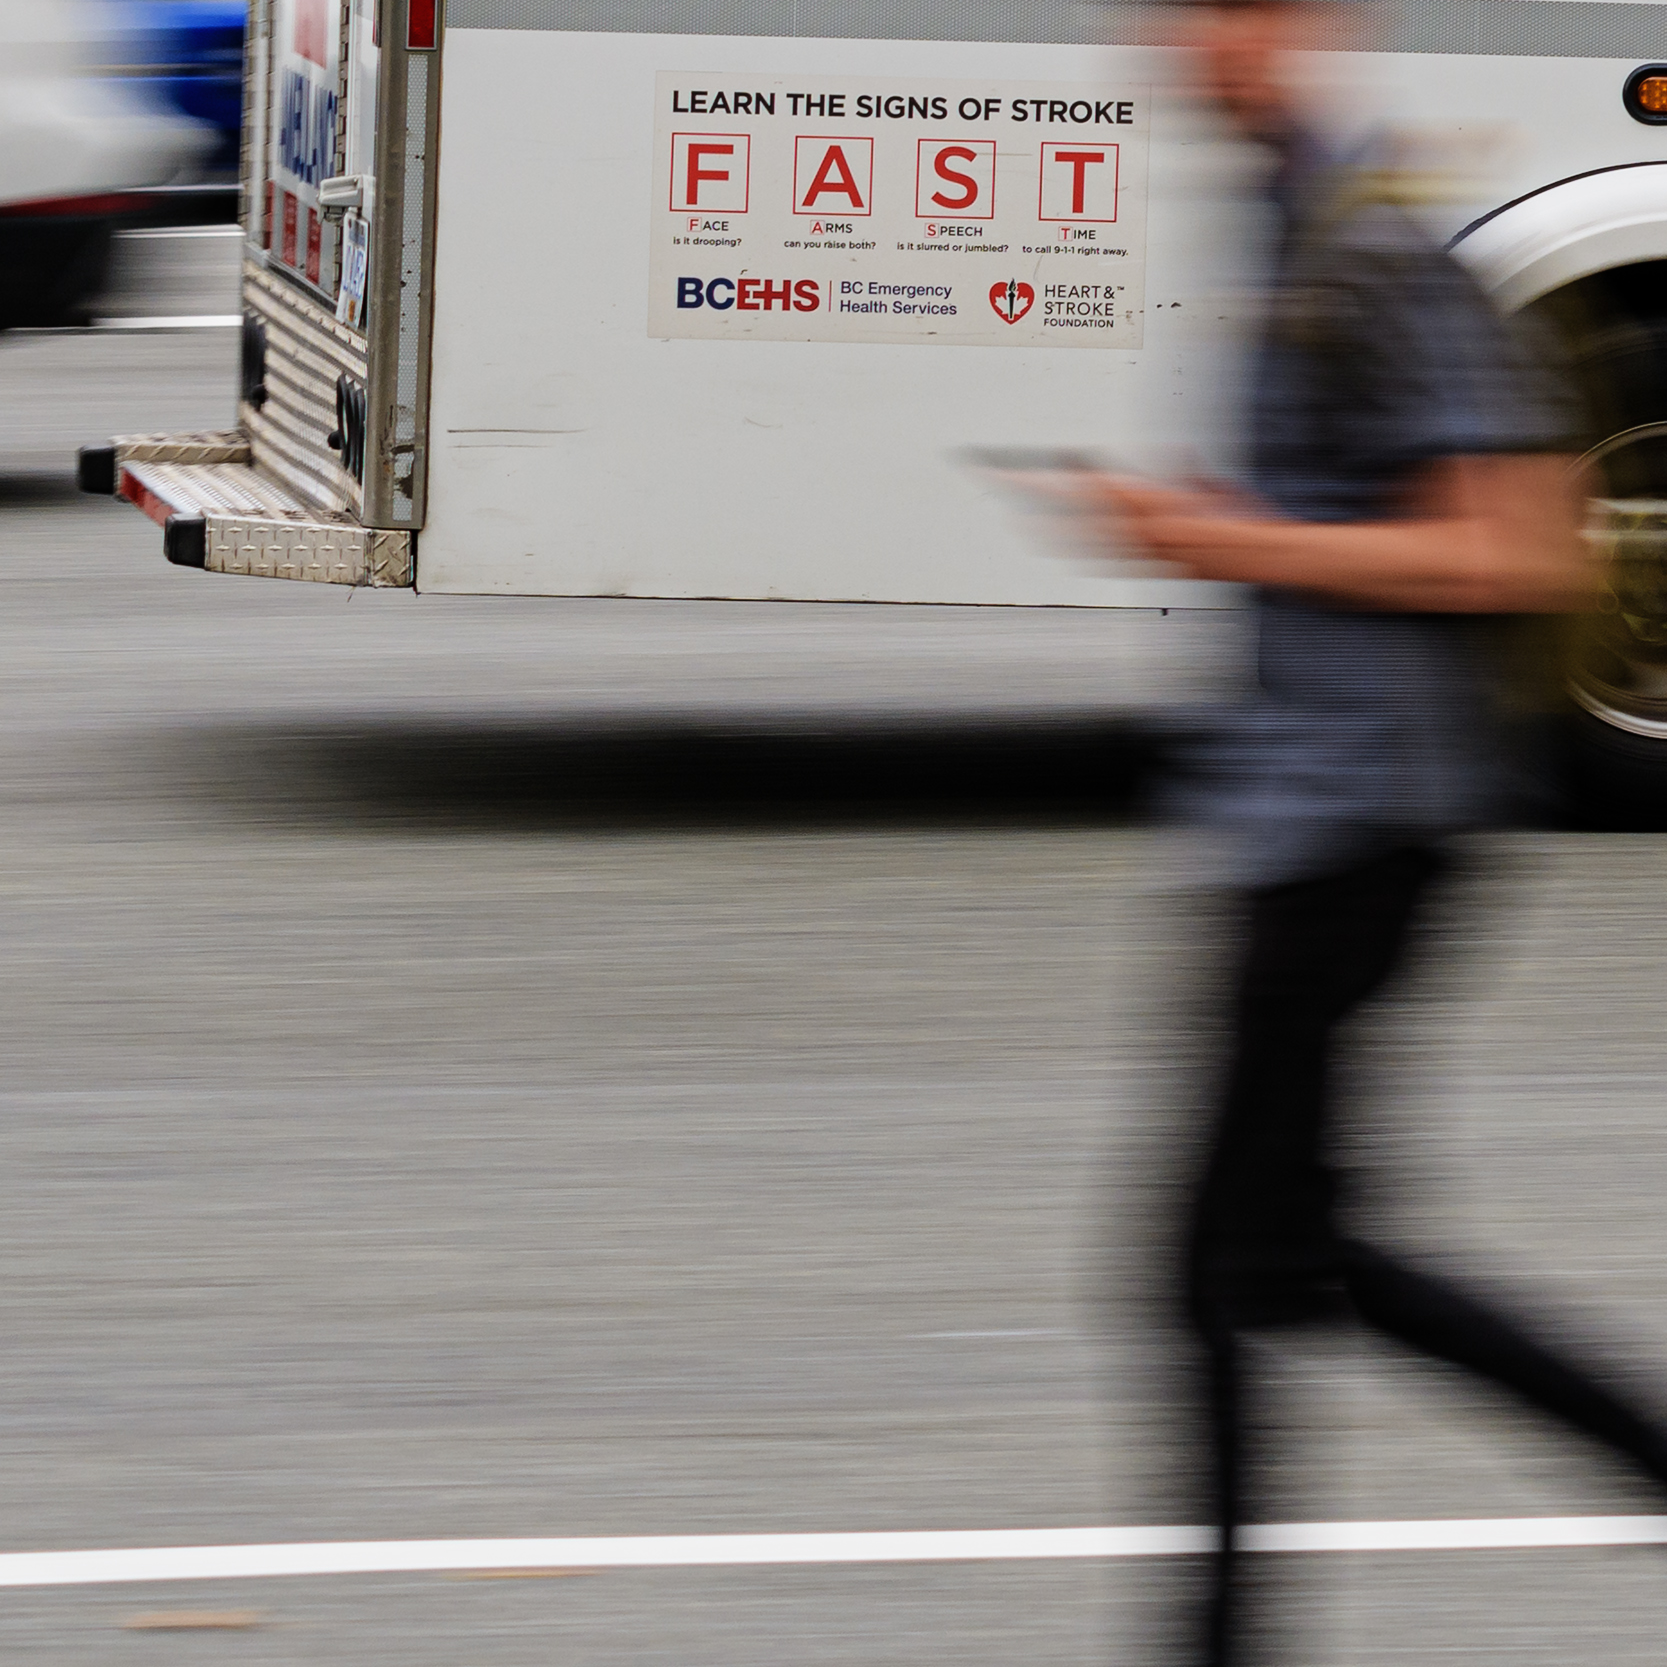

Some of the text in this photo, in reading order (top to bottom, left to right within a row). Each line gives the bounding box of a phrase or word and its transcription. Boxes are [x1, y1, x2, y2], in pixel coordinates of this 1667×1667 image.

[673, 90, 1134, 124] LEARN THE SIGNS OF STROKE
[672, 236, 743, 248] is it drooping?
[783, 240, 877, 250] can you raise both?
[896, 241, 1009, 254] is it slurred or jumbled?
[1022, 245, 1129, 258] to call 9-1-1 right away.
[677, 277, 820, 312] BCEHS
[841, 281, 952, 299] BC Emergency
[1045, 285, 1101, 298] HEART
[840, 300, 957, 315] Health Services
[1044, 301, 1115, 317] STROKE
[1043, 317, 1115, 329] FOUNDATION
